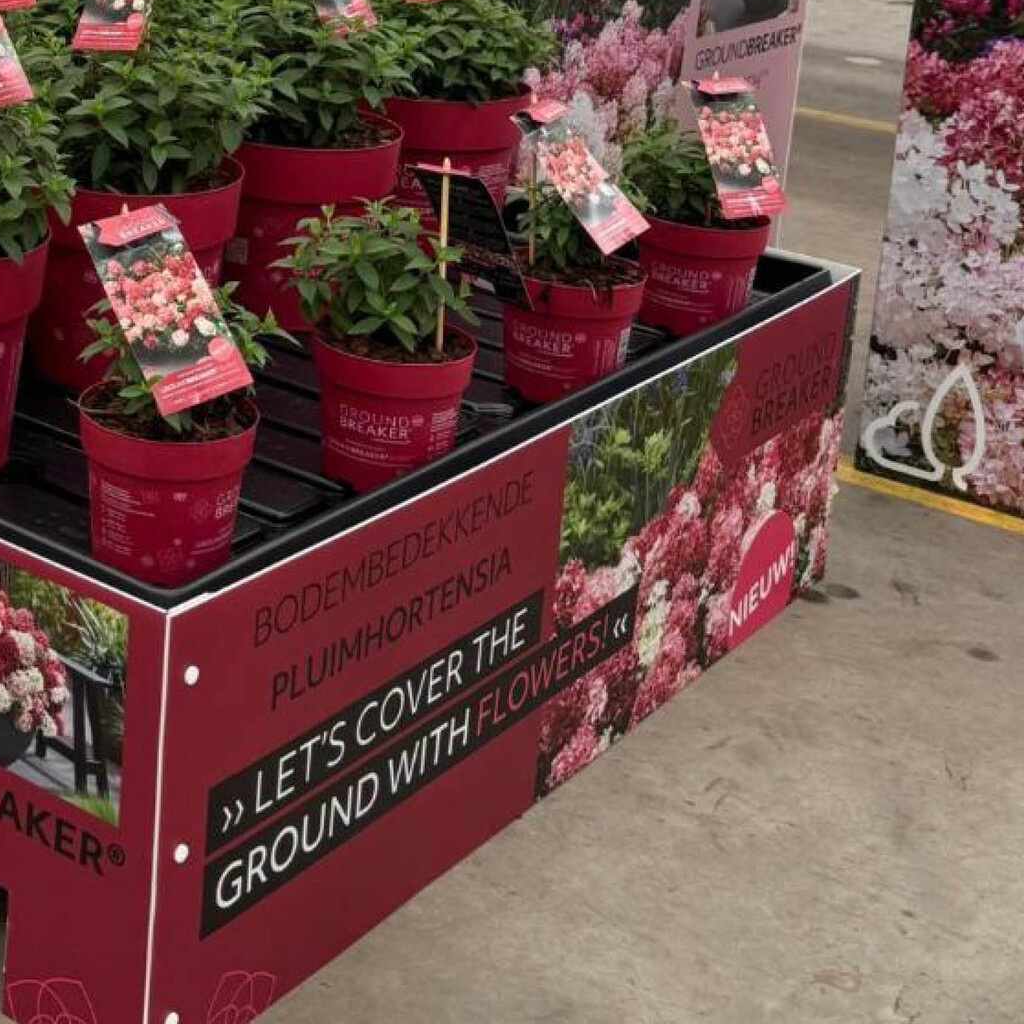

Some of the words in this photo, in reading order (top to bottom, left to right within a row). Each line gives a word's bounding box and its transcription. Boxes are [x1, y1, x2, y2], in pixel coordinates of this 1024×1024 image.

[340, 403, 409, 428] GROUND
[253, 471, 536, 649] BODEMBEDEKKENDE
[270, 545, 514, 711] PLUIMHORTENSIA
[729, 540, 795, 637] NIEUW!
[356, 649, 463, 747] COVER
[472, 606, 529, 674] THE
[215, 771, 380, 910] GROUND
[387, 707, 471, 794] WITH
[476, 613, 612, 736] FLOWERS!
